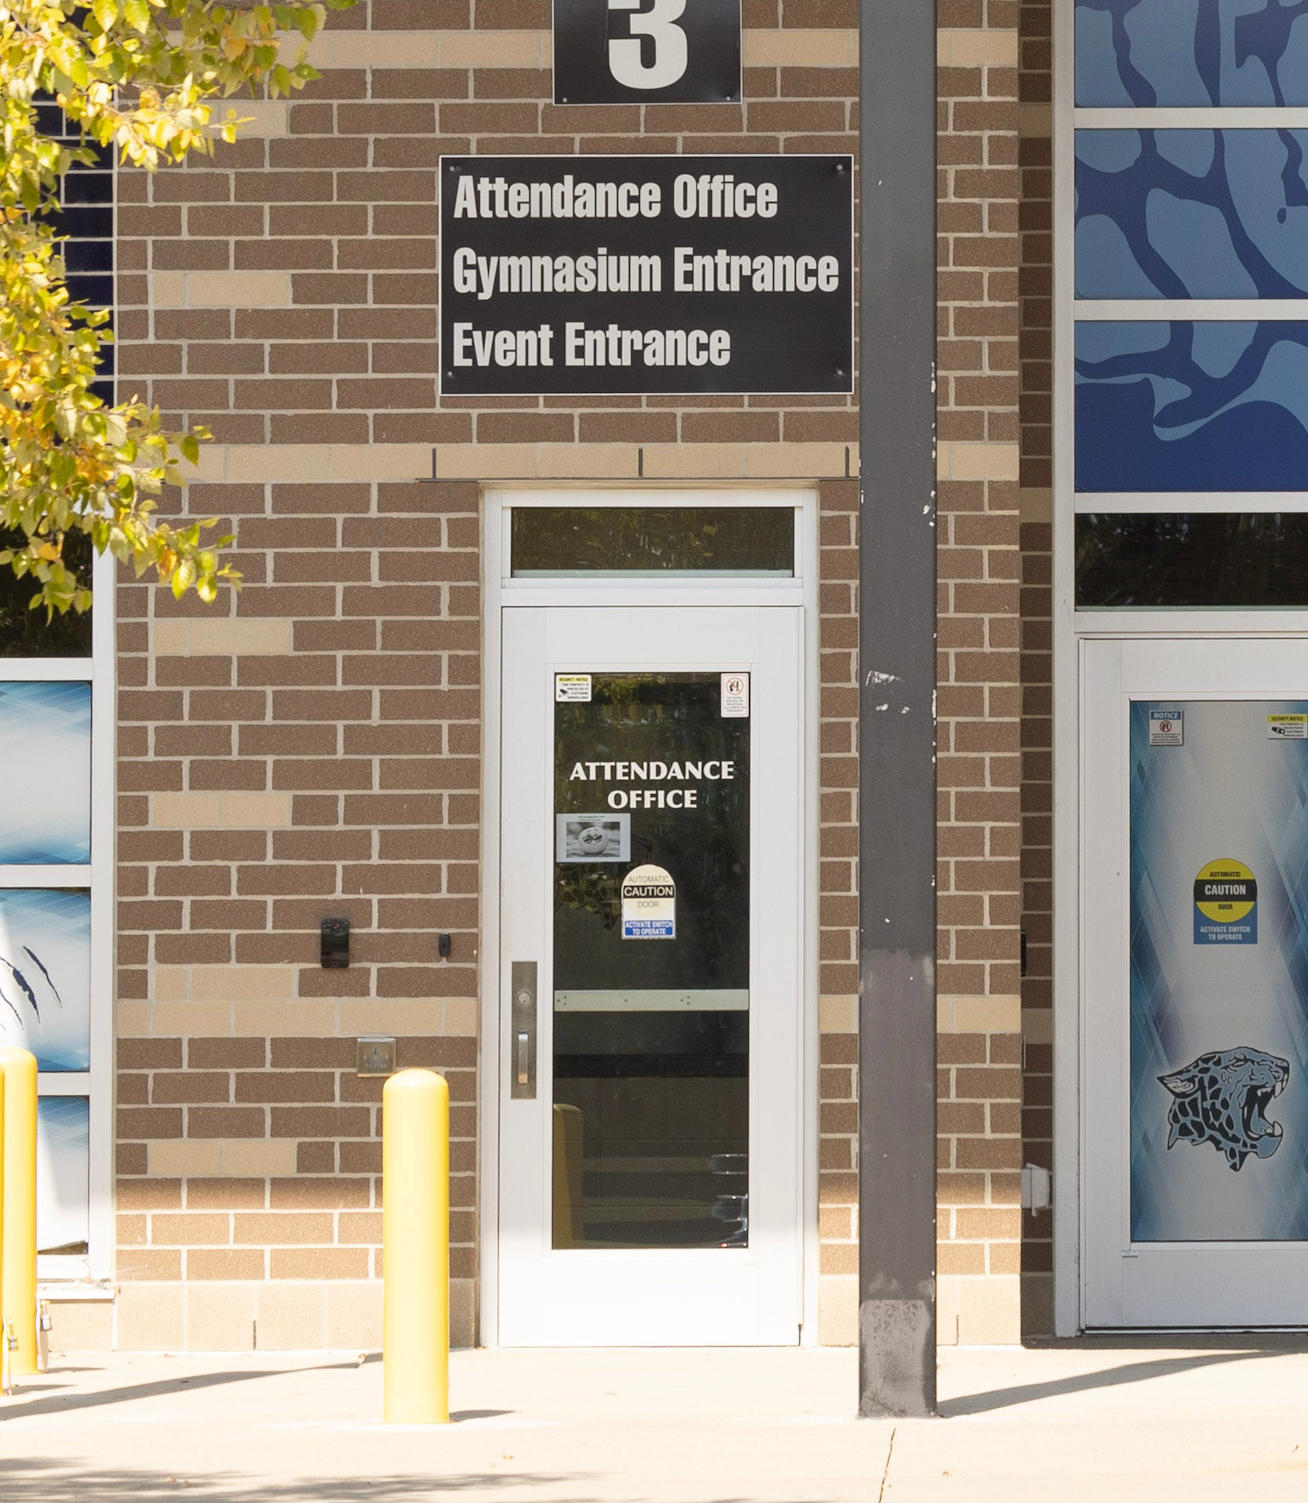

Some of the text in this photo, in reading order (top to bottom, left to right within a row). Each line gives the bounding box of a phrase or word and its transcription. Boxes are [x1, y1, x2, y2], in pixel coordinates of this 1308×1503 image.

[453, 173, 779, 219] Attendance Office
[453, 246, 840, 301] Gymnasium Entrance
[452, 321, 732, 367] Event Entrance
[1153, 711, 1179, 719] NOTICE
[569, 761, 735, 781] ATTENDANCE
[607, 789, 698, 809] OFFICE
[628, 875, 671, 884] AUTOMATIC
[623, 886, 674, 897] CAUTION
[1204, 884, 1247, 896] CAUTION
[637, 900, 660, 909] DOOR
